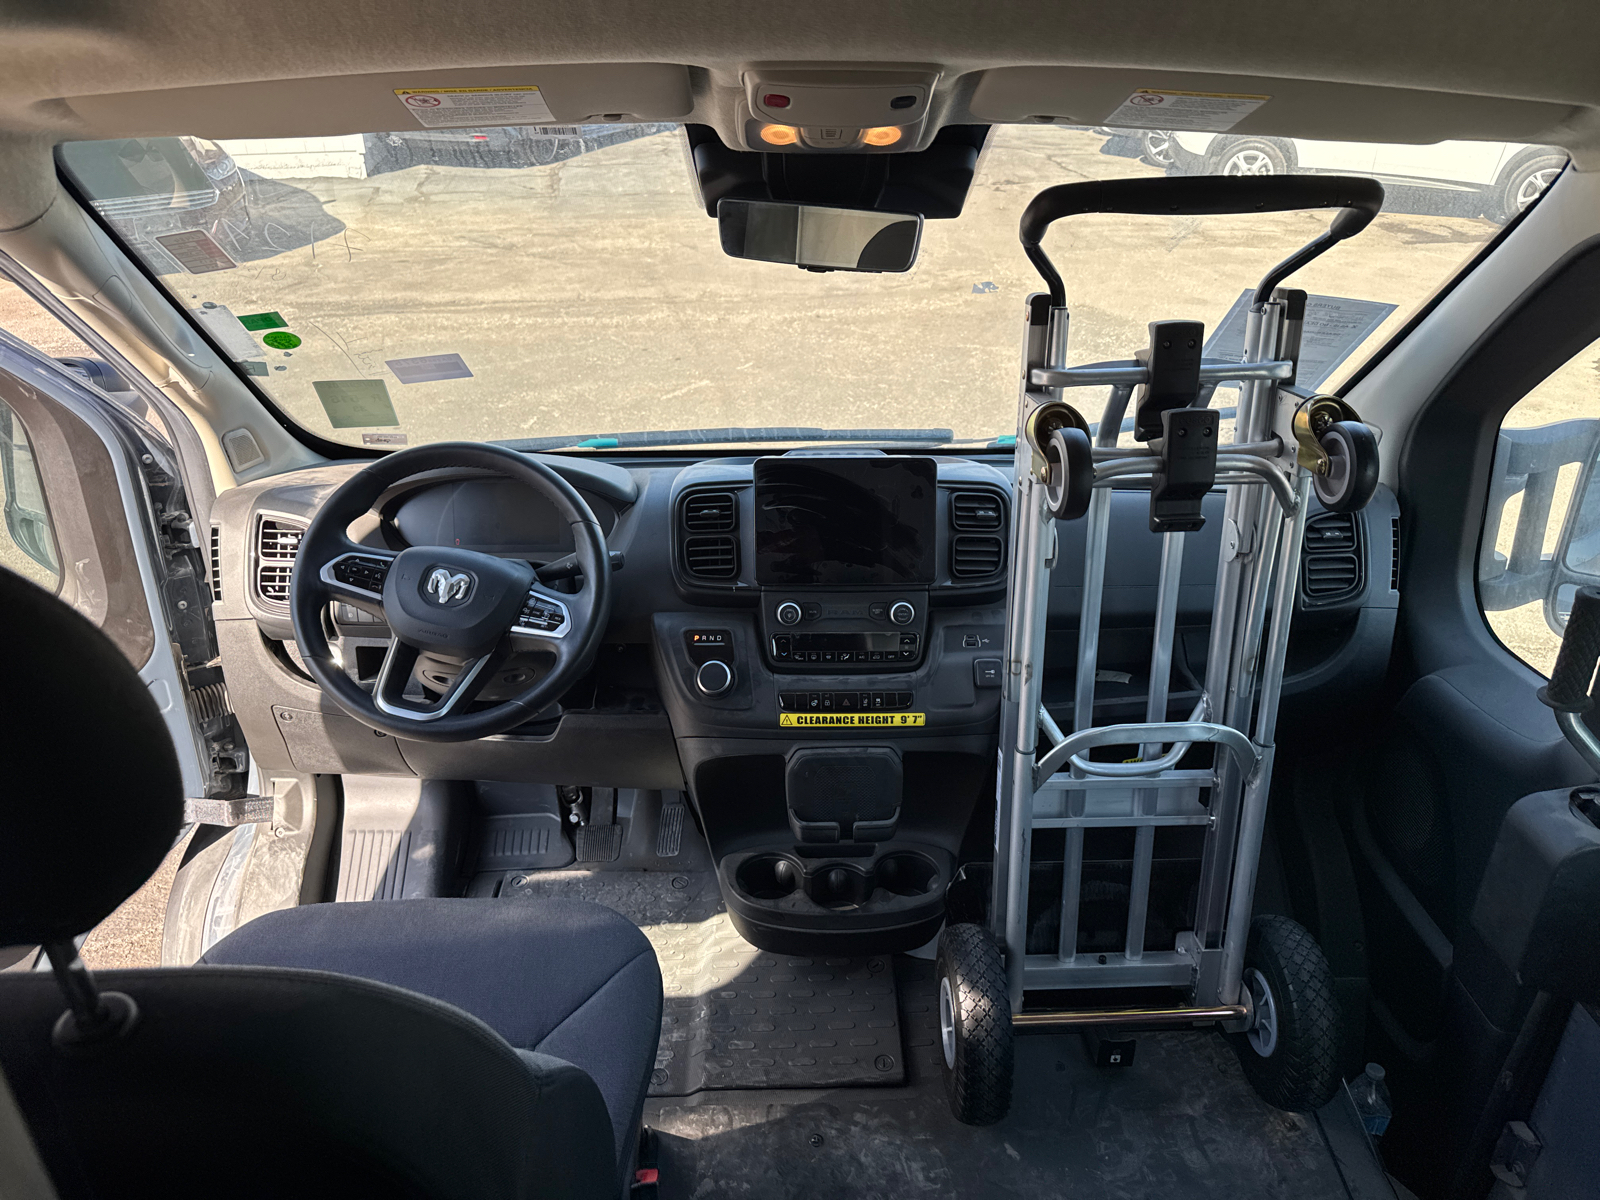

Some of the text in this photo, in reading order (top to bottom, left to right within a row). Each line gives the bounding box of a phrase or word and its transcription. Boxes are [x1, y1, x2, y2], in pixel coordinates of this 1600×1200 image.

[796, 715, 855, 725] CLEARANCE
[858, 715, 895, 725] HEIGHT
[900, 715, 910, 724] 9'
